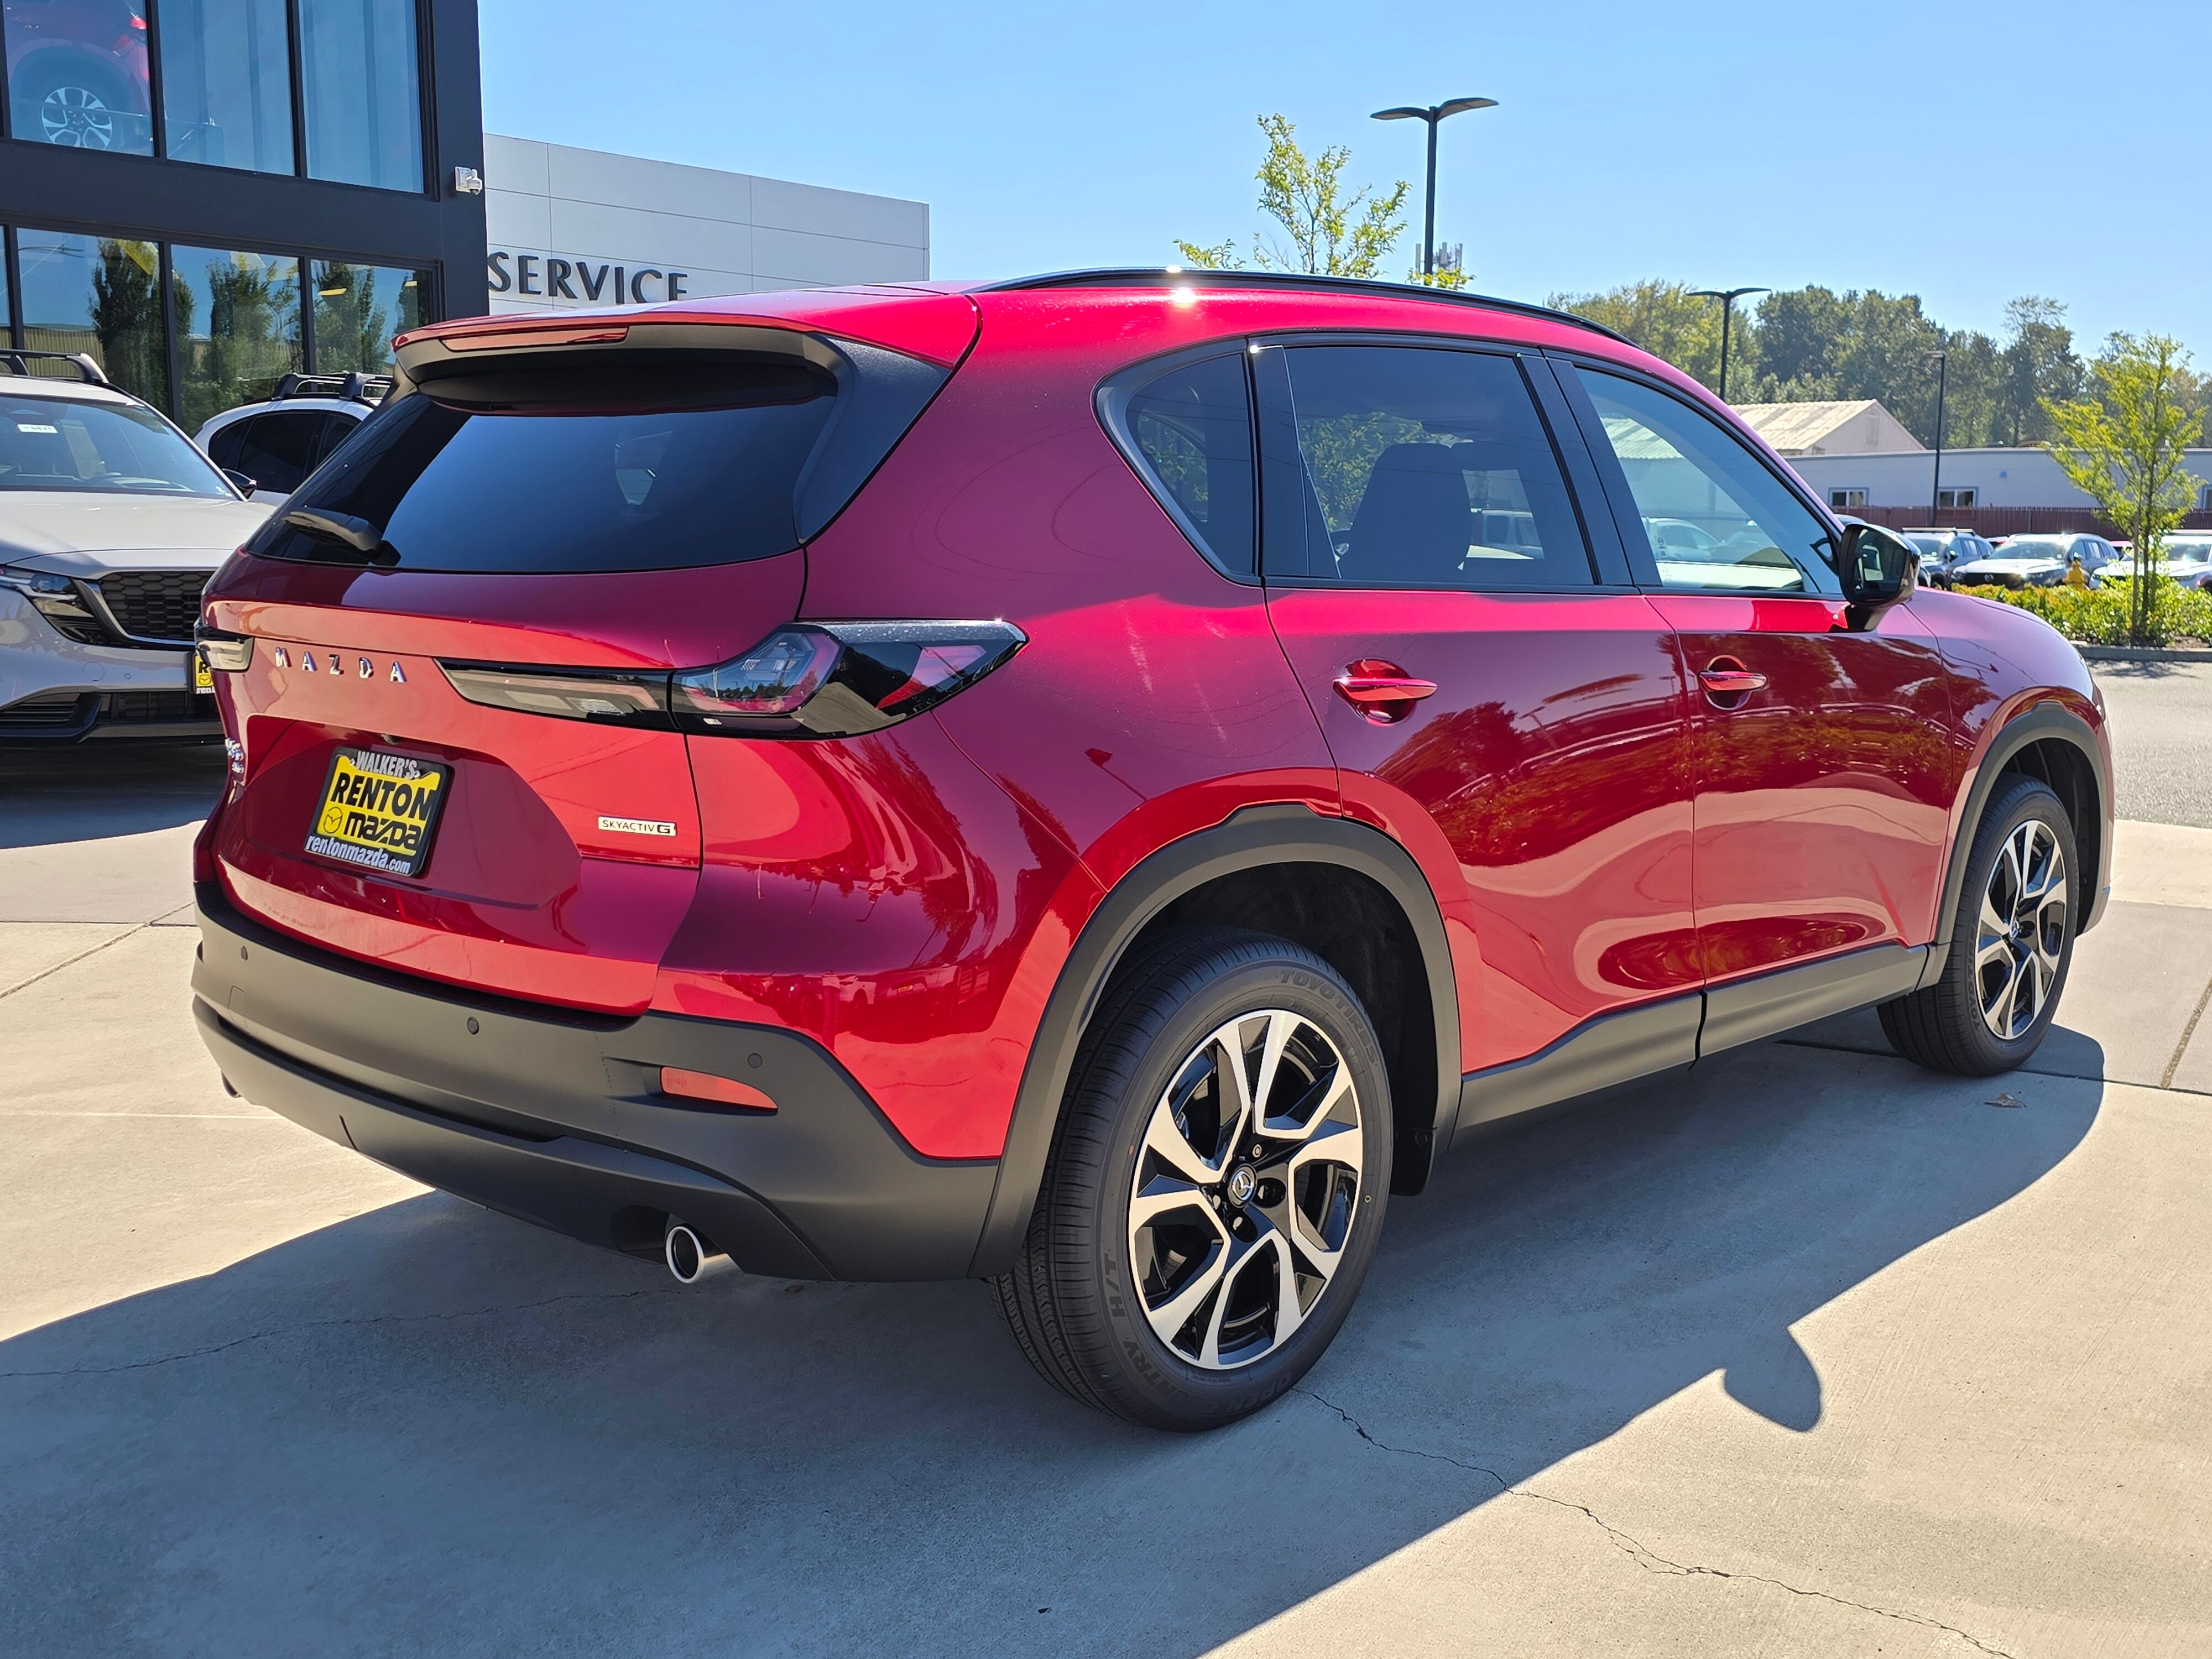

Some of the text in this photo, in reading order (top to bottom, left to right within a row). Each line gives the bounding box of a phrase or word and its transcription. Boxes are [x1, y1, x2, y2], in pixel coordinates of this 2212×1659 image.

[487, 252, 687, 305] SERVICE
[275, 647, 407, 683] MAZDA
[356, 751, 418, 779] WALKER'S
[330, 772, 435, 821] RENTON
[343, 811, 421, 850] mazda
[602, 820, 655, 832] SKYACTIV
[305, 835, 411, 874] rentonmazda.com
[1280, 969, 1335, 1000] TOYO
